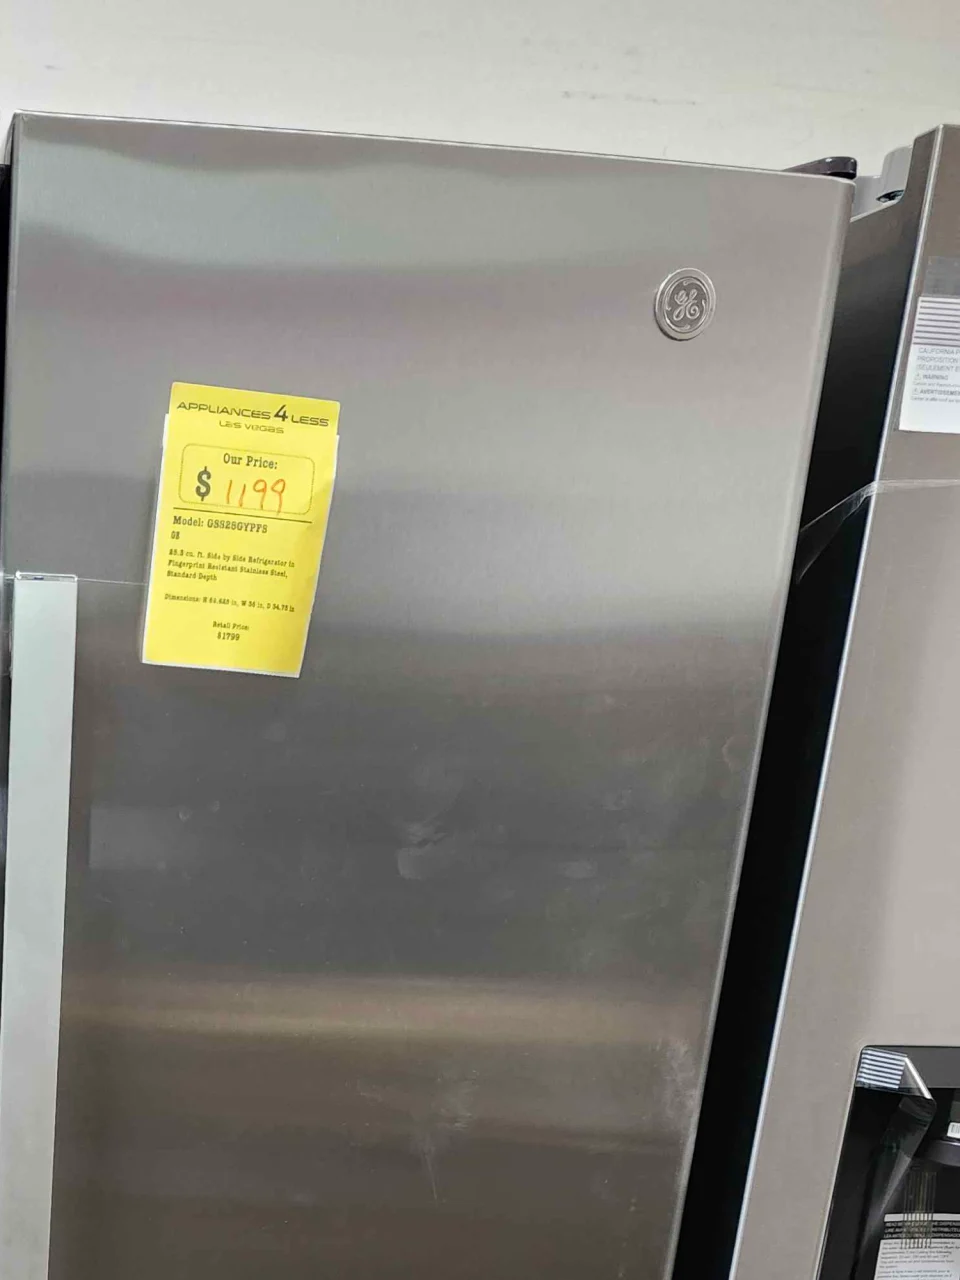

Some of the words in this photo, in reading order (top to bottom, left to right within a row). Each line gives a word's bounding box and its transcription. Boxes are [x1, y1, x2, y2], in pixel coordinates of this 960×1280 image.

[177, 401, 271, 420] APPLIANCES
[273, 404, 289, 422] 4
[291, 415, 330, 427] LESS
[223, 453, 243, 465] Our
[246, 455, 278, 470] Price:
[195, 466, 212, 502] $
[225, 478, 286, 516] 1199
[173, 515, 204, 527] Model:
[167, 559, 205, 570] Fingerprint
[207, 562, 238, 573] Resistant
[240, 566, 269, 576] Stainless
[207, 552, 221, 560] Side
[222, 553, 231, 562] by
[232, 554, 246, 562] Side
[248, 556, 288, 567] Refrigerator
[166, 570, 197, 580] Standard
[198, 572, 218, 582] Depth
